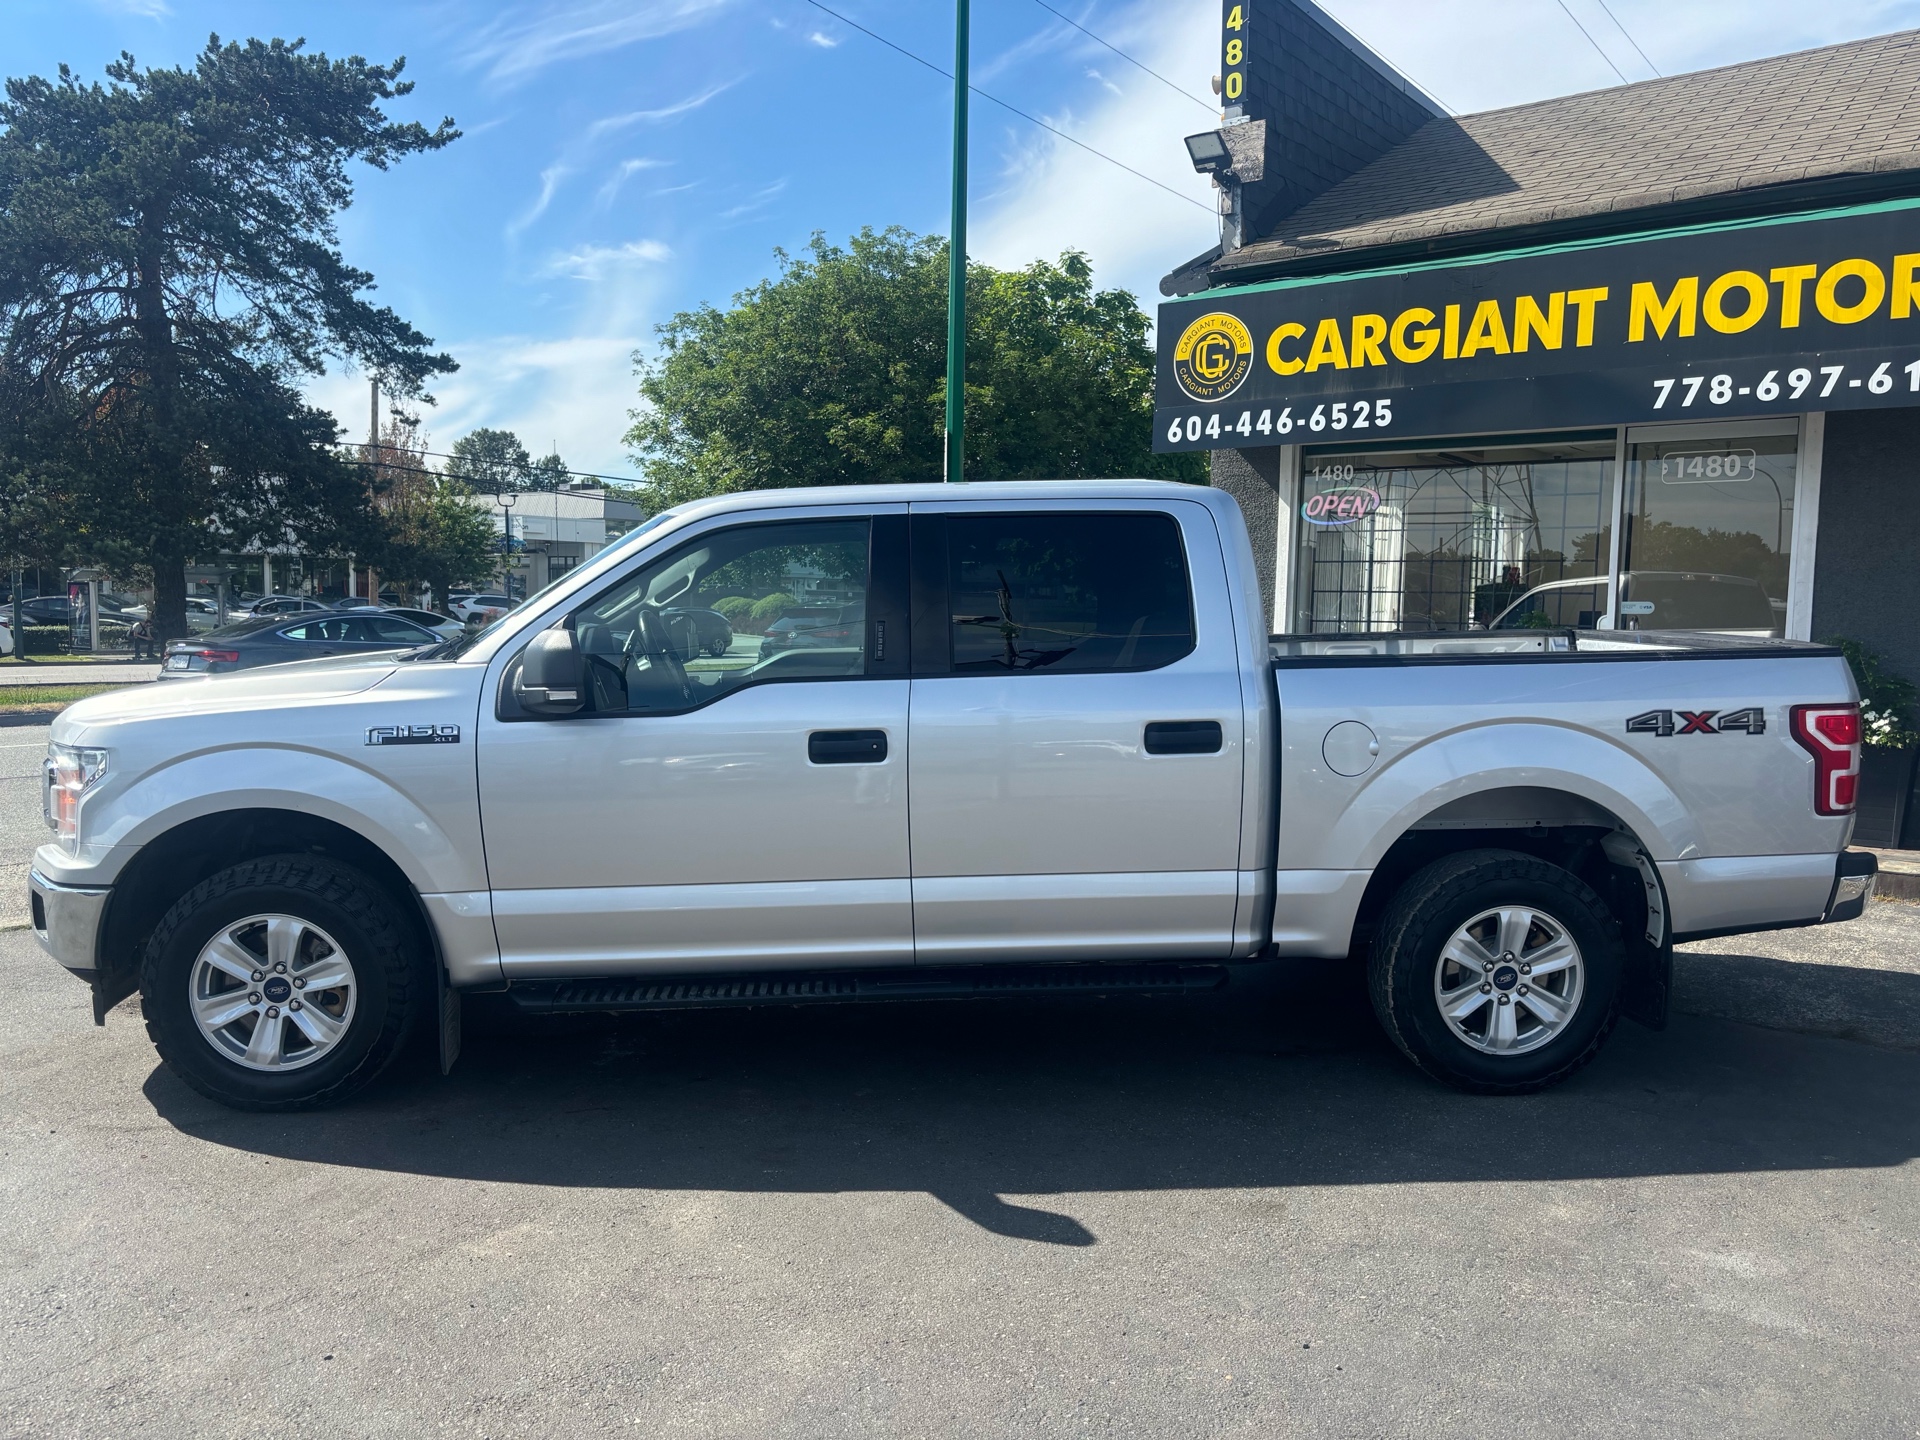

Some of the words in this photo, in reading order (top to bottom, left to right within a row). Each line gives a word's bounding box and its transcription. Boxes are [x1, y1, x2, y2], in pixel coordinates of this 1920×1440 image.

[1181, 319, 1215, 354] CARGIANT
[1219, 319, 1246, 349] MOTORS
[1266, 286, 1609, 376] CARGIANT
[1179, 367, 1213, 396] CARGIANT
[1217, 360, 1247, 394] MOTORS
[1167, 399, 1393, 444] 604-446-6525
[1312, 464, 1354, 482] 1480
[1674, 454, 1741, 479] 1480
[1306, 495, 1371, 518] OPEN
